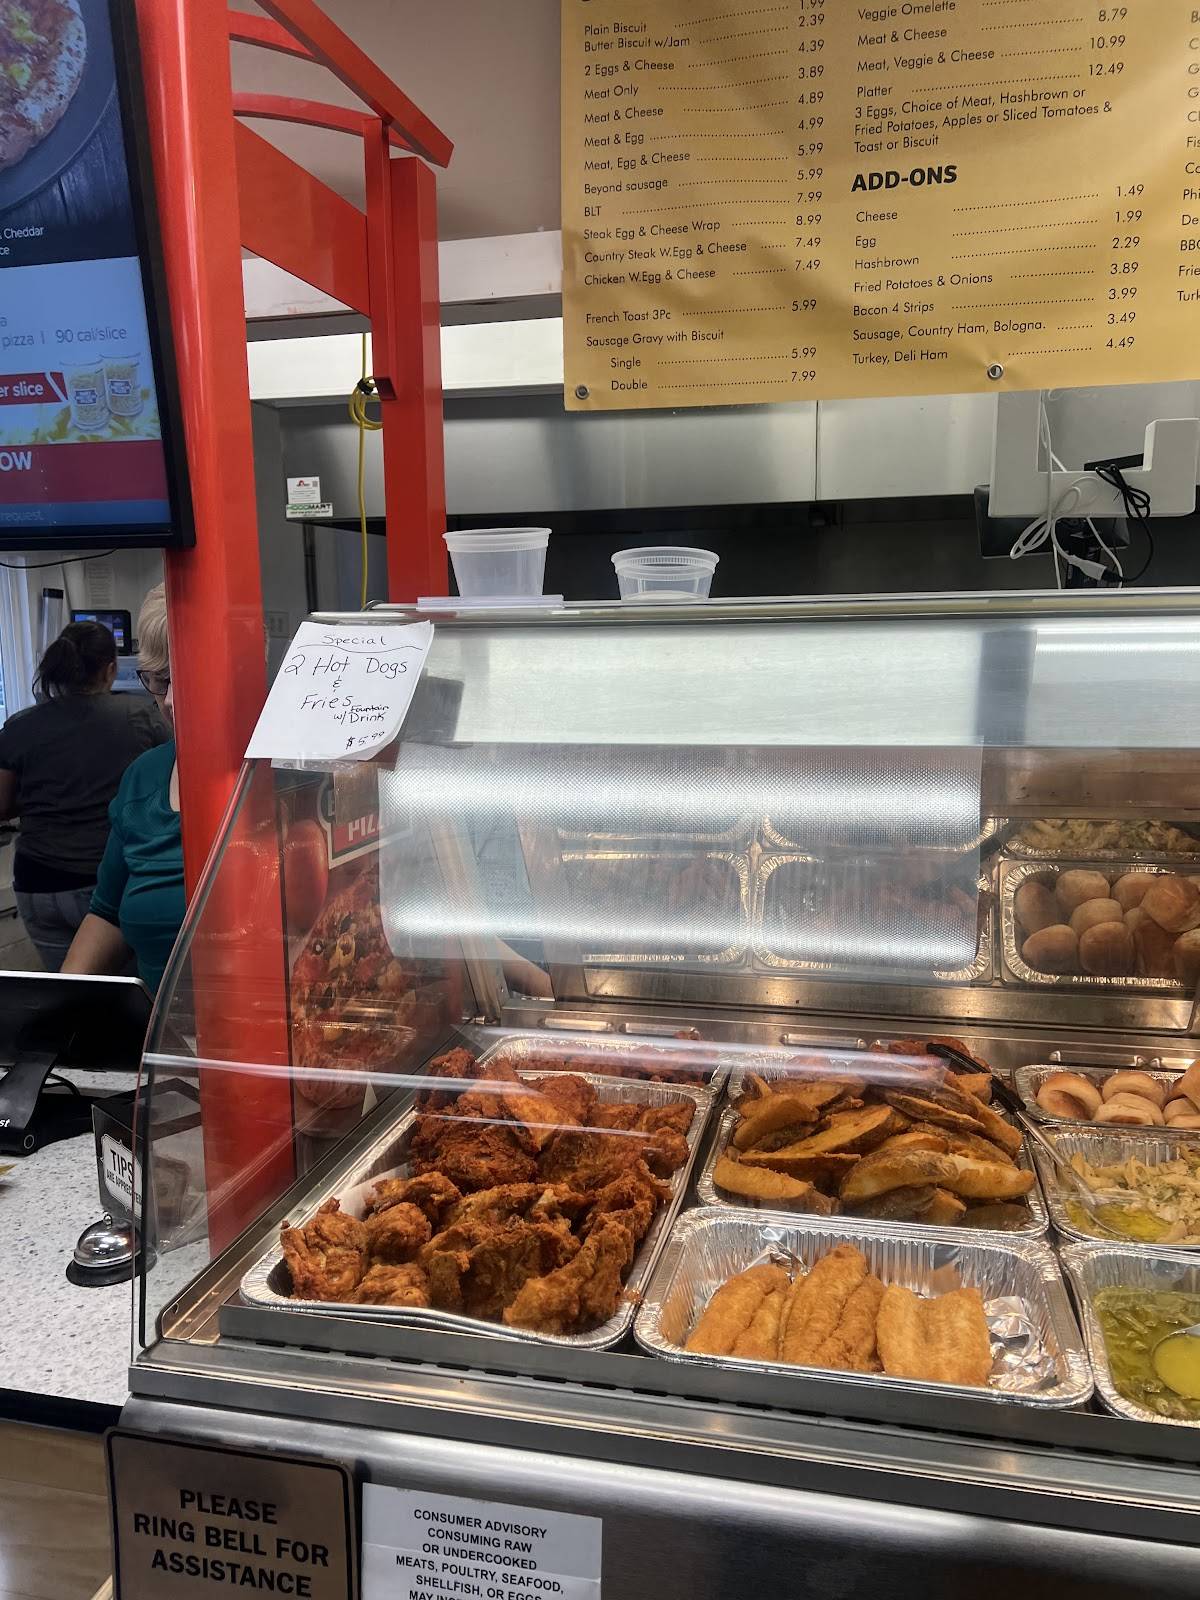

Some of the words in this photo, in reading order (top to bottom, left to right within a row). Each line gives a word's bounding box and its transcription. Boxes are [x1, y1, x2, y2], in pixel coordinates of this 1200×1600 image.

[858, 8, 897, 21] Veggie
[901, 2, 956, 15] Omelette
[585, 25, 610, 36] Plain
[614, 22, 646, 33] Biscuit
[585, 41, 613, 52] Butter
[618, 38, 651, 48] Biscuit
[655, 36, 690, 48] w/Jam
[798, 14, 824, 27] 2.39
[858, 34, 886, 46] Meat
[890, 31, 899, 42] &
[903, 28, 948, 40] Cheese
[1098, 8, 1128, 22] 8.79
[584, 66, 590, 76] 2
[595, 62, 619, 76] Eggs
[622, 61, 630, 71] &
[634, 60, 674, 71] Cheese
[798, 40, 824, 52] 4.39
[857, 58, 888, 72] Meat,
[893, 54, 934, 70] Veggie
[937, 52, 946, 65] &
[950, 48, 995, 62] Cheese
[1090, 35, 1126, 49] 10.99
[584, 88, 610, 100] Meat
[614, 84, 639, 96] Only
[798, 66, 824, 79] 3.89
[857, 85, 893, 98] Platter
[1088, 62, 1124, 76] 12.49
[584, 112, 610, 124] Meat
[614, 110, 621, 121] &
[625, 106, 664, 119] Cheese
[798, 91, 824, 104] 4.89
[854, 122, 882, 136] Fried
[887, 118, 938, 134] Potatoes,
[942, 112, 982, 128] Apples
[986, 113, 999, 122] or
[1003, 107, 1038, 121] Sliced
[1042, 103, 1099, 118] Tomatoes
[1103, 101, 1112, 113] &
[856, 106, 862, 118] 3
[866, 104, 897, 120] Eggs,
[901, 100, 942, 115] Choice
[946, 97, 958, 110] of
[962, 94, 995, 108] Meat,
[1000, 88, 1068, 104] Hashbrown
[1073, 88, 1086, 98] or
[584, 136, 610, 148] Meat
[614, 134, 621, 144] &
[625, 133, 644, 145] Egg
[798, 117, 824, 130] 4.99
[855, 140, 882, 152] Toast
[886, 141, 899, 149] or
[903, 136, 939, 148] Biscuit
[584, 160, 613, 171] Meat,
[617, 157, 636, 169] Egg
[640, 155, 648, 166] &
[651, 151, 690, 164] Cheese
[798, 142, 824, 156] 5.99
[585, 183, 622, 195] Beyond
[626, 178, 668, 192] sausage
[797, 168, 823, 180] 5.99
[851, 164, 958, 192] ADD-ONS
[585, 206, 602, 217] BLT
[797, 191, 822, 203] 7.99
[856, 210, 898, 222] Cheese
[1117, 184, 1144, 197] 1.49
[4, 226, 44, 240] Cheddar
[584, 228, 612, 240] Steak
[616, 227, 635, 239] Egg
[638, 226, 646, 237] &
[650, 224, 688, 236] Cheese
[692, 220, 720, 234] Wrap
[796, 214, 822, 226] 8.99
[855, 236, 877, 248] Egg
[1116, 210, 1142, 223] 1.99
[584, 251, 624, 263] Country
[628, 248, 656, 260] Steak
[660, 246, 693, 259] W.Egg
[696, 244, 704, 255] &
[708, 241, 747, 254] Cheese
[795, 237, 821, 248] 7.49
[855, 255, 919, 270] Hashbrown
[1112, 236, 1140, 249] 2.29
[584, 274, 625, 286] Chicken
[629, 271, 661, 284] W.Egg
[665, 270, 673, 281] &
[677, 267, 716, 280] Cheese
[795, 260, 821, 271] 7.49
[854, 281, 882, 293] Fried
[886, 278, 933, 291] Potatoes
[937, 276, 946, 287] &
[950, 273, 993, 286] Onions
[1110, 262, 1139, 275] 3.89
[586, 312, 619, 324] French
[623, 311, 649, 322] Toast
[652, 310, 671, 320] 3Pc
[791, 300, 817, 312] 5.99
[853, 304, 887, 317] Bacon
[892, 303, 899, 313] 4
[903, 301, 934, 314] Strips
[1108, 287, 1137, 300] 3.99
[56, 329, 74, 344] 90
[586, 335, 629, 348] Sausage
[632, 333, 663, 345] Gravy
[666, 331, 687, 342] with
[691, 330, 724, 341] Biscuit
[853, 328, 904, 342] Sausage,
[908, 325, 953, 338] Country
[957, 322, 989, 336] Ham,
[1107, 312, 1136, 325] 3.49
[611, 357, 641, 369] Single
[791, 347, 816, 359] 5.99
[853, 352, 890, 366] Turkey,
[894, 350, 916, 363] Deli
[920, 348, 948, 361] Ham
[1106, 336, 1135, 349] 4.49
[13, 382, 44, 397] slice
[611, 380, 647, 391] Double
[791, 370, 816, 382] 7.99
[322, 635, 386, 646] Special
[284, 654, 306, 675] 2
[312, 654, 350, 676] Hot
[366, 657, 408, 679] Dogs
[333, 712, 346, 725] w/
[350, 712, 386, 724] Drink
[180, 1489, 277, 1524] PLEASE
[414, 1508, 482, 1529] CONSUMER
[485, 1520, 548, 1538] ADVISORY
[134, 1513, 195, 1543] RING
[205, 1526, 267, 1556] BELL
[276, 1538, 329, 1567] FOR
[428, 1528, 501, 1548] CONSUMING
[504, 1539, 532, 1553] RAW
[422, 1543, 439, 1554] OR
[443, 1547, 537, 1571] UNDERCOOKED
[152, 1549, 312, 1597] ASSISTANCE
[396, 1555, 438, 1573] MEATS,
[442, 1564, 498, 1583] POULTRY,
[502, 1574, 564, 1594] SEAFOOD,
[416, 1575, 483, 1597] SHELLFISH,
[486, 1588, 504, 1599] OR
